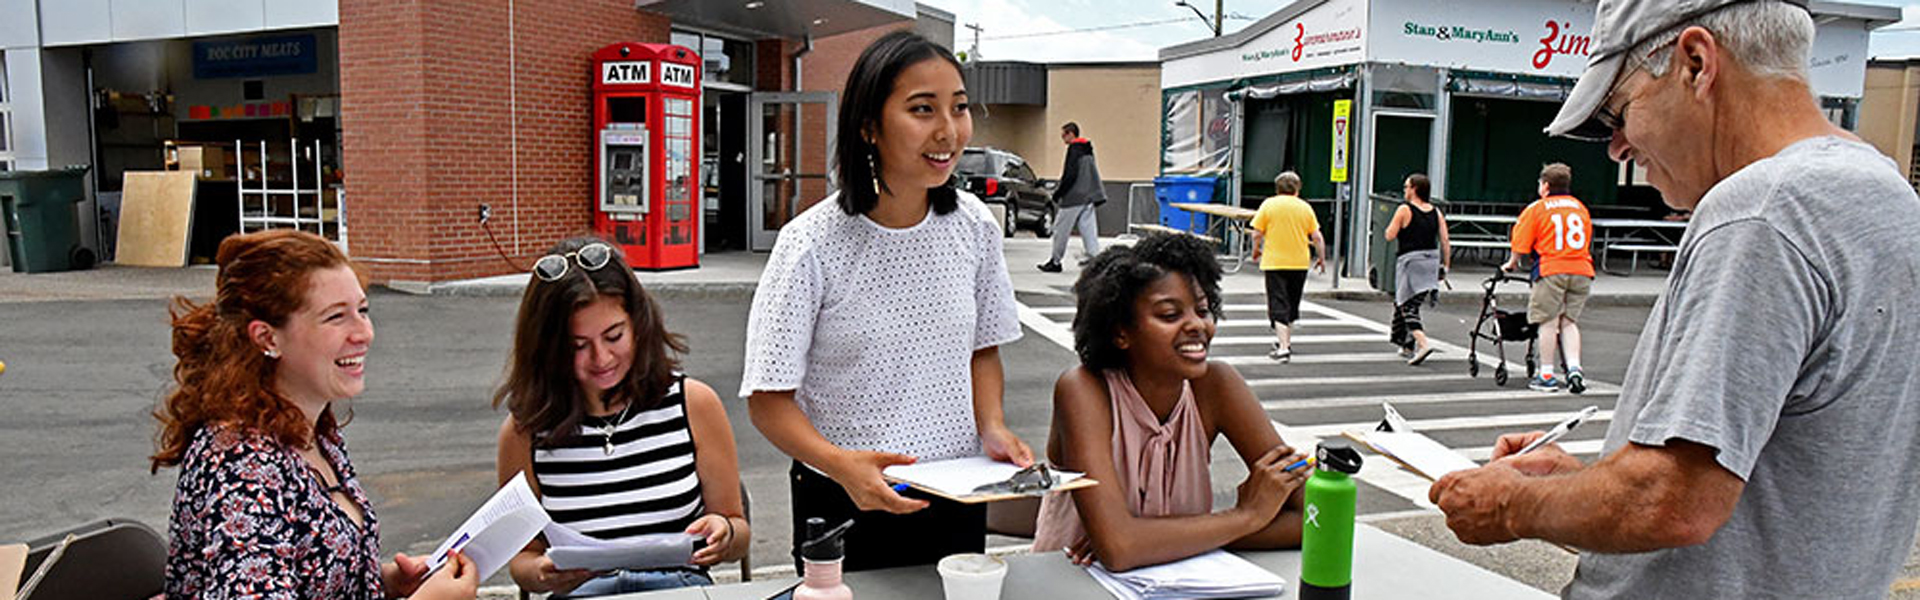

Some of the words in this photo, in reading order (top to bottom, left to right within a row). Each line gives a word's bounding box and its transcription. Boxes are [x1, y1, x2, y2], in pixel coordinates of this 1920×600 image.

[1404, 22, 1436, 37] Stan
[1451, 26, 1519, 43] MaryAnn's
[232, 44, 259, 59] CITY
[261, 42, 301, 57] MEATS
[1532, 19, 1592, 69] Zim
[607, 64, 647, 81] ATM
[663, 66, 692, 85] ATM
[1551, 213, 1585, 250] 18
